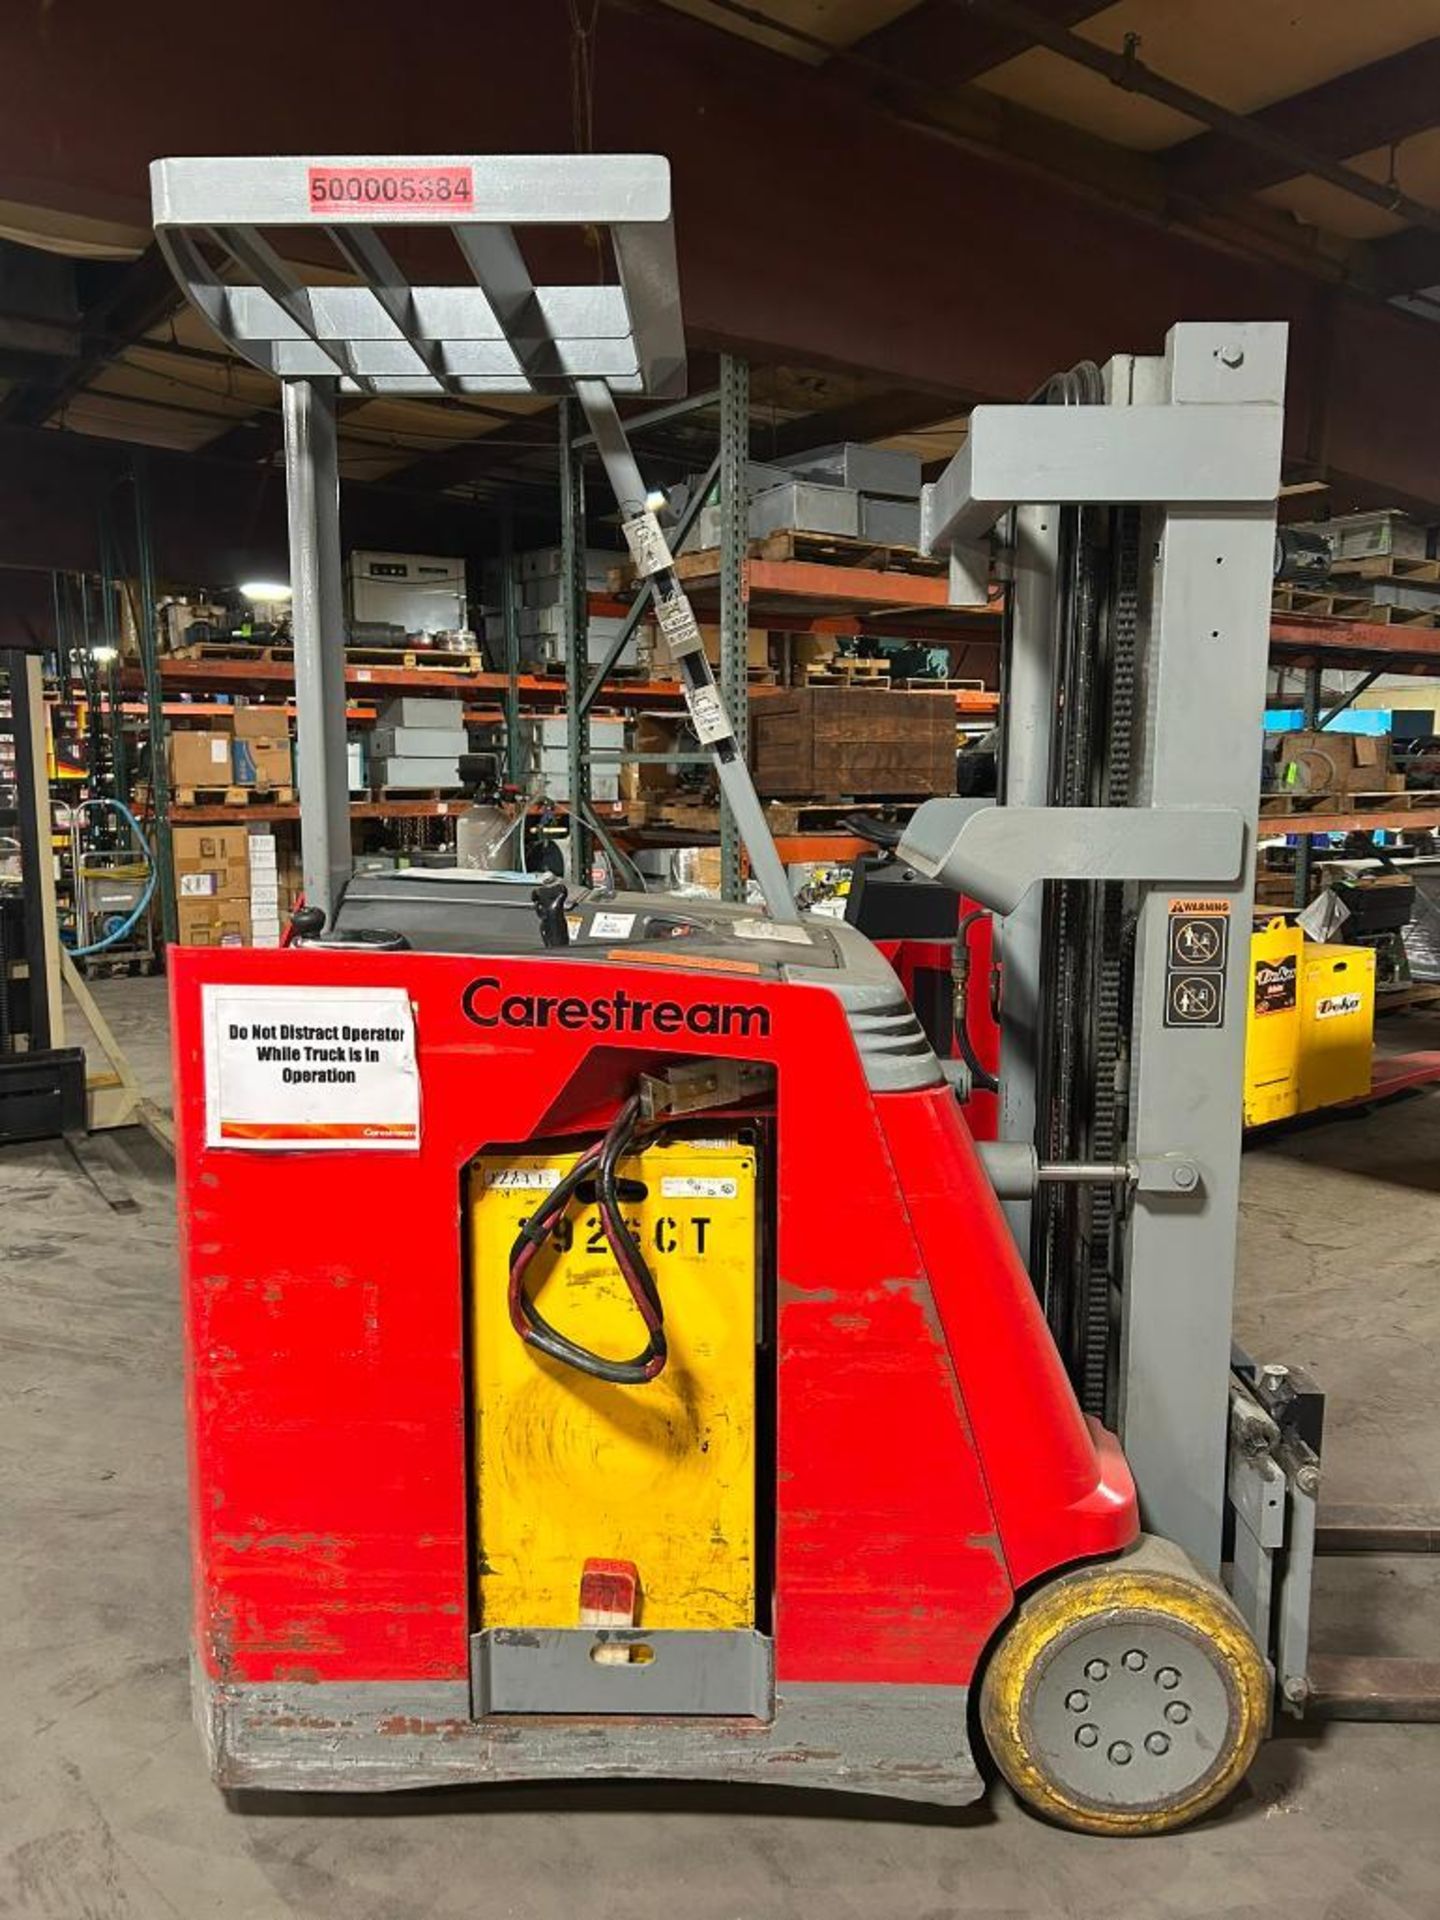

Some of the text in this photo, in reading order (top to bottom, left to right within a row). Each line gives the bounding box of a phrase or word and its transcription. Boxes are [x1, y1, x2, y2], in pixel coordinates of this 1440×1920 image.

[311, 177, 471, 201] 500005384
[461, 975, 771, 1037] Carestream
[229, 1024, 405, 1042] Do Not Distract Operator
[257, 1046, 300, 1061] While
[303, 1046, 346, 1062] Truck
[282, 1067, 356, 1084] Operation
